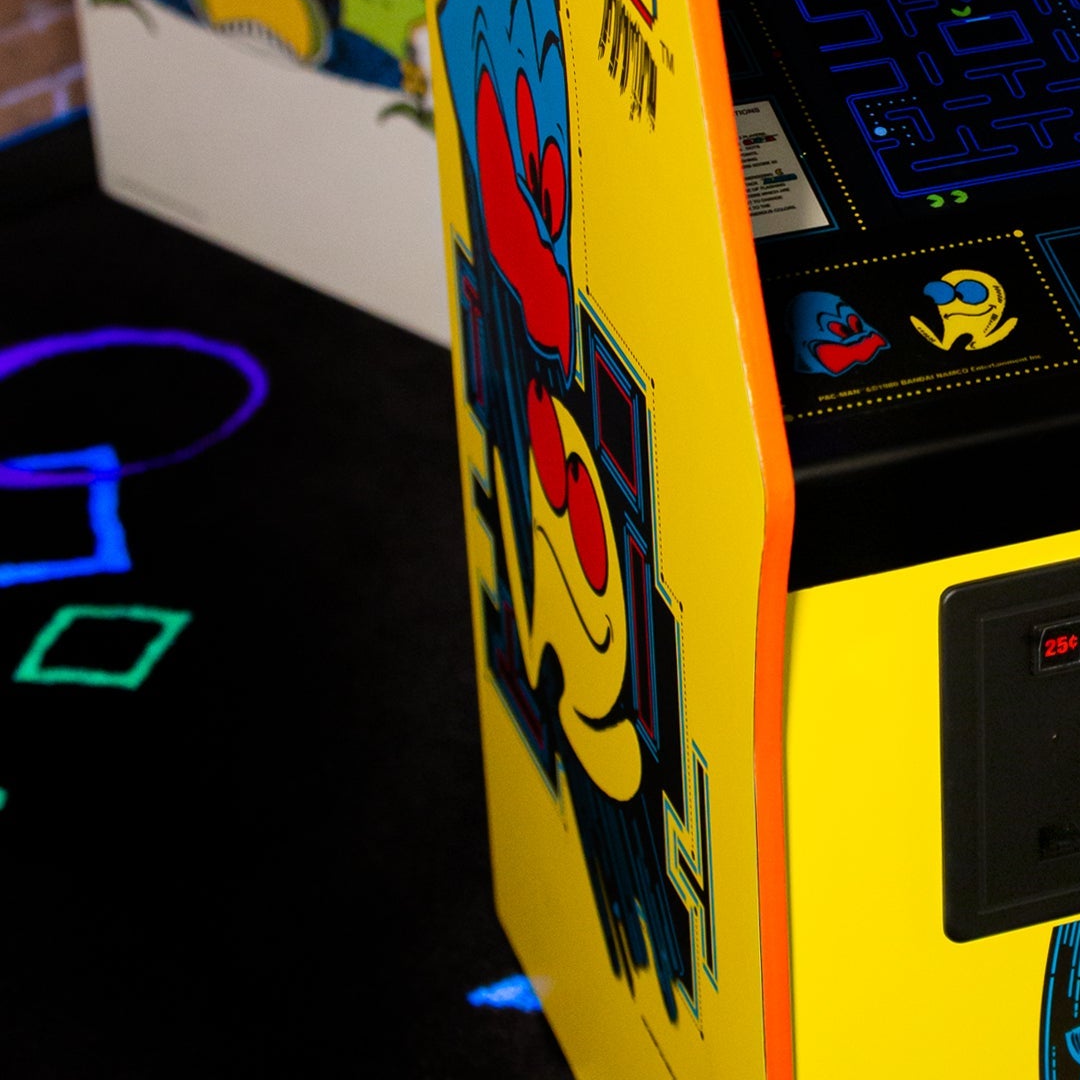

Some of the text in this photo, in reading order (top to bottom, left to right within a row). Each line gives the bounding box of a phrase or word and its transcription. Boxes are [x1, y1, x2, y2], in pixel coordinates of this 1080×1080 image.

[900, 373, 935, 387] BANDAI
[936, 368, 969, 380] NAMCO
[1044, 633, 1078, 658] 25¢
